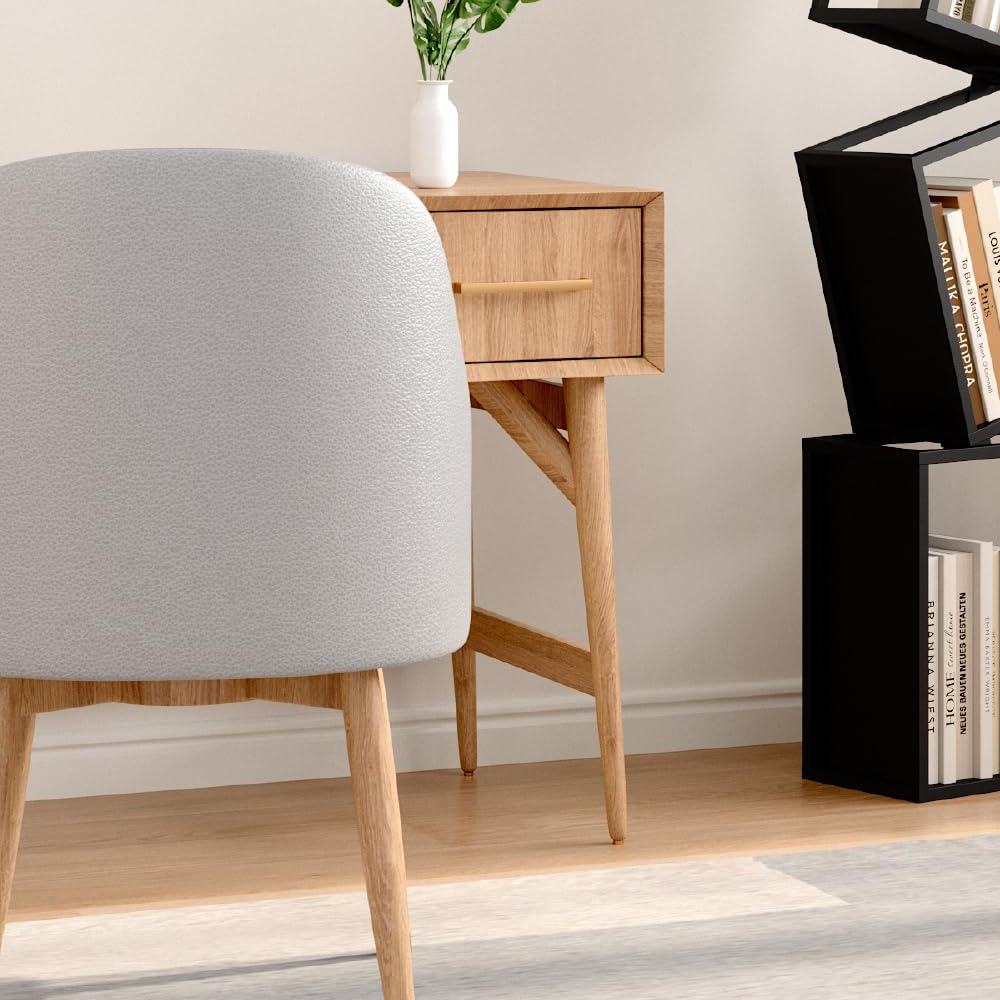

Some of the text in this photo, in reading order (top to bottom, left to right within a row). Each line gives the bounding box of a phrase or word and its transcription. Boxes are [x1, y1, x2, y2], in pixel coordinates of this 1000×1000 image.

[960, 257, 969, 270] To
[963, 271, 973, 286] Be
[977, 282, 995, 318] Paris
[945, 671, 954, 725] HOME
